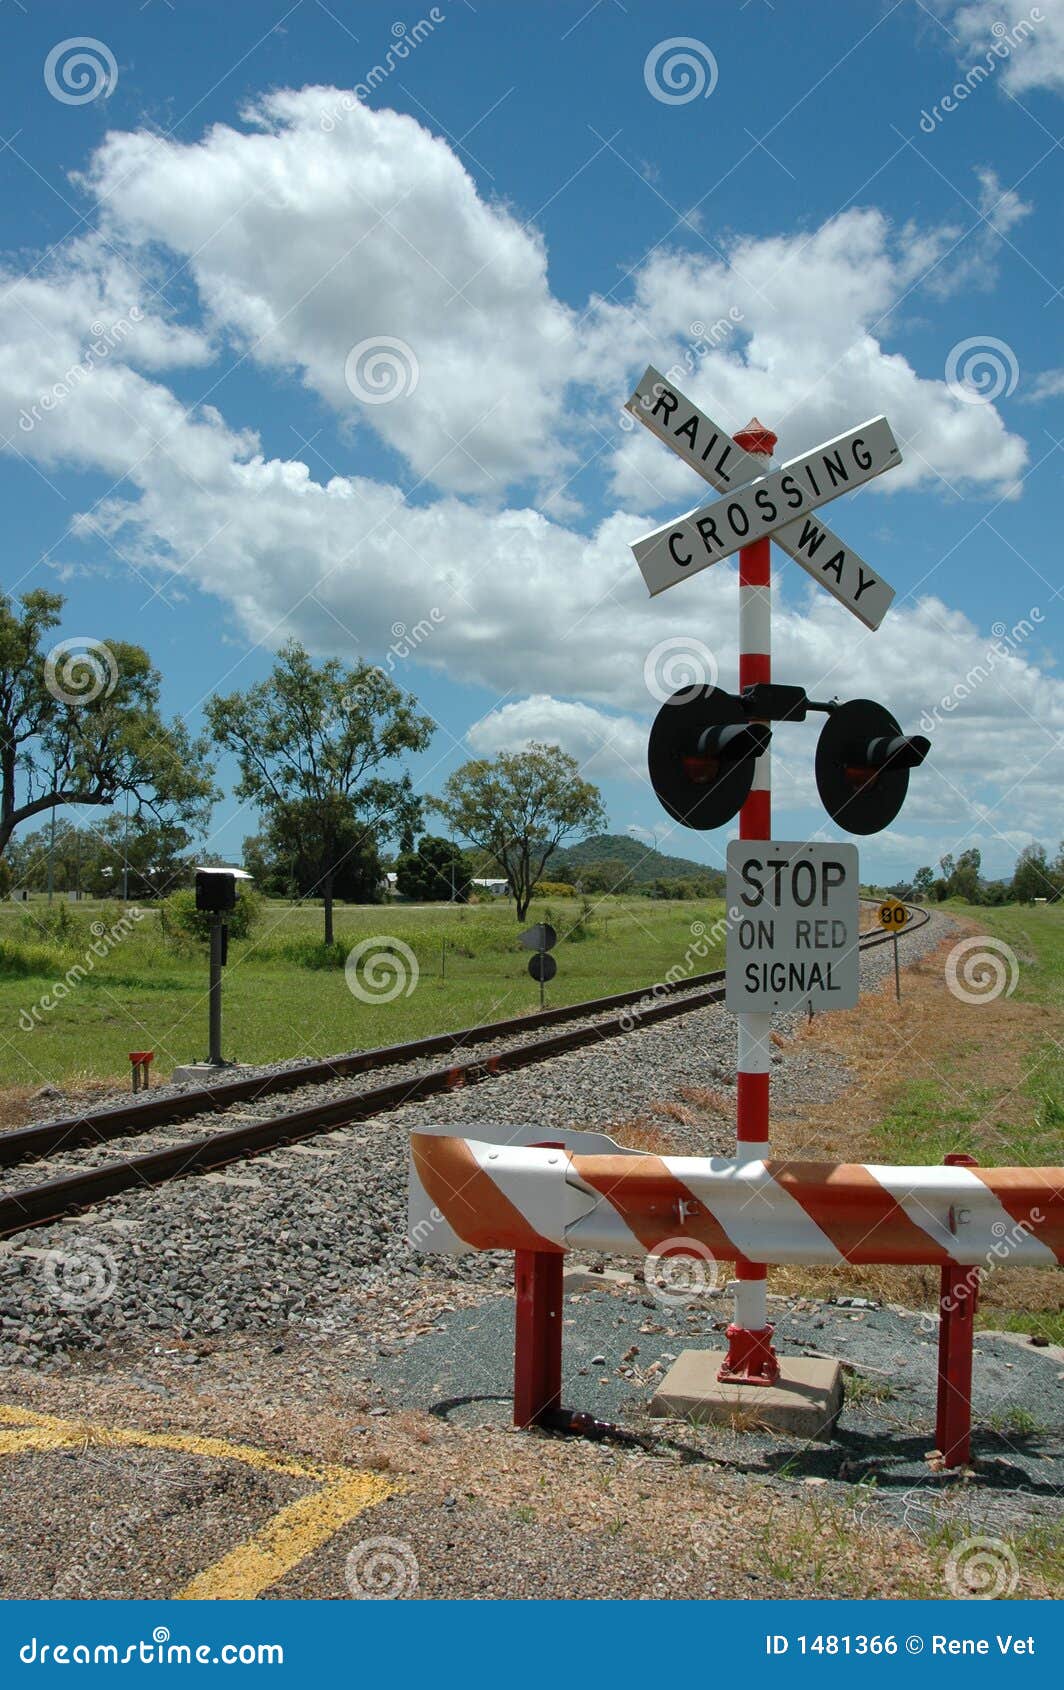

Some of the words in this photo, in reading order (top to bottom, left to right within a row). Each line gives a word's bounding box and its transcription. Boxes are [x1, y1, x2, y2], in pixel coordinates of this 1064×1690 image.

[651, 389, 732, 482] RAIL
[798, 519, 876, 601] WAY
[668, 438, 873, 568] CROSSING
[740, 859, 846, 907] STOP
[739, 919, 775, 950] ON
[795, 919, 848, 949] RED
[744, 962, 842, 993] SIGNAL
